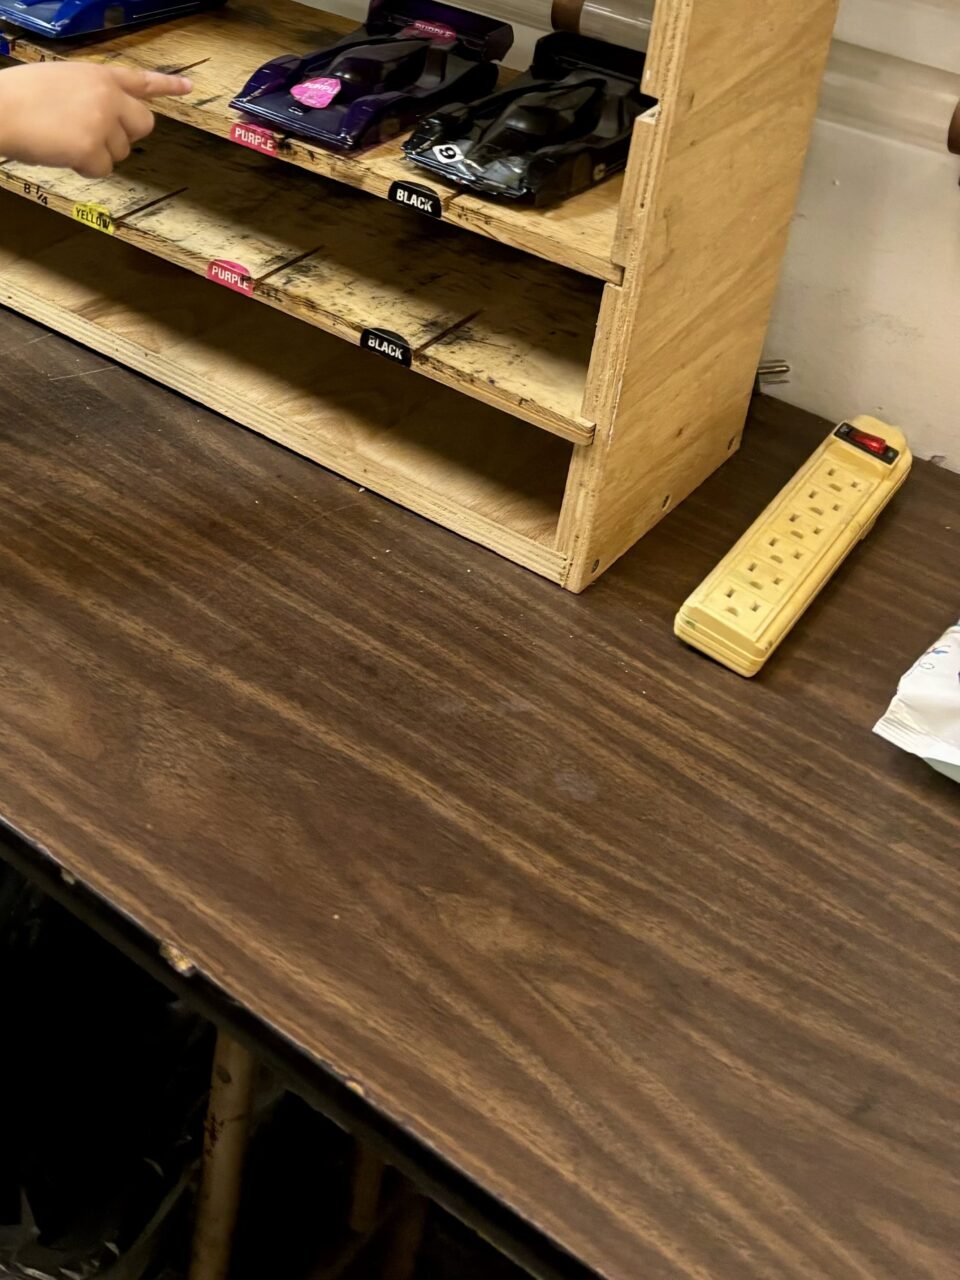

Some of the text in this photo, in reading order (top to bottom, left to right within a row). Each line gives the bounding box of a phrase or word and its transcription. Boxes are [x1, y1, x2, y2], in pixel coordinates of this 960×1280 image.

[235, 127, 275, 151] PURPLE
[23, 182, 31, 194] B
[396, 188, 433, 212] BLACK
[75, 206, 110, 231] YELLOW
[211, 266, 249, 291] PURPLE
[368, 334, 403, 360] BLACK
